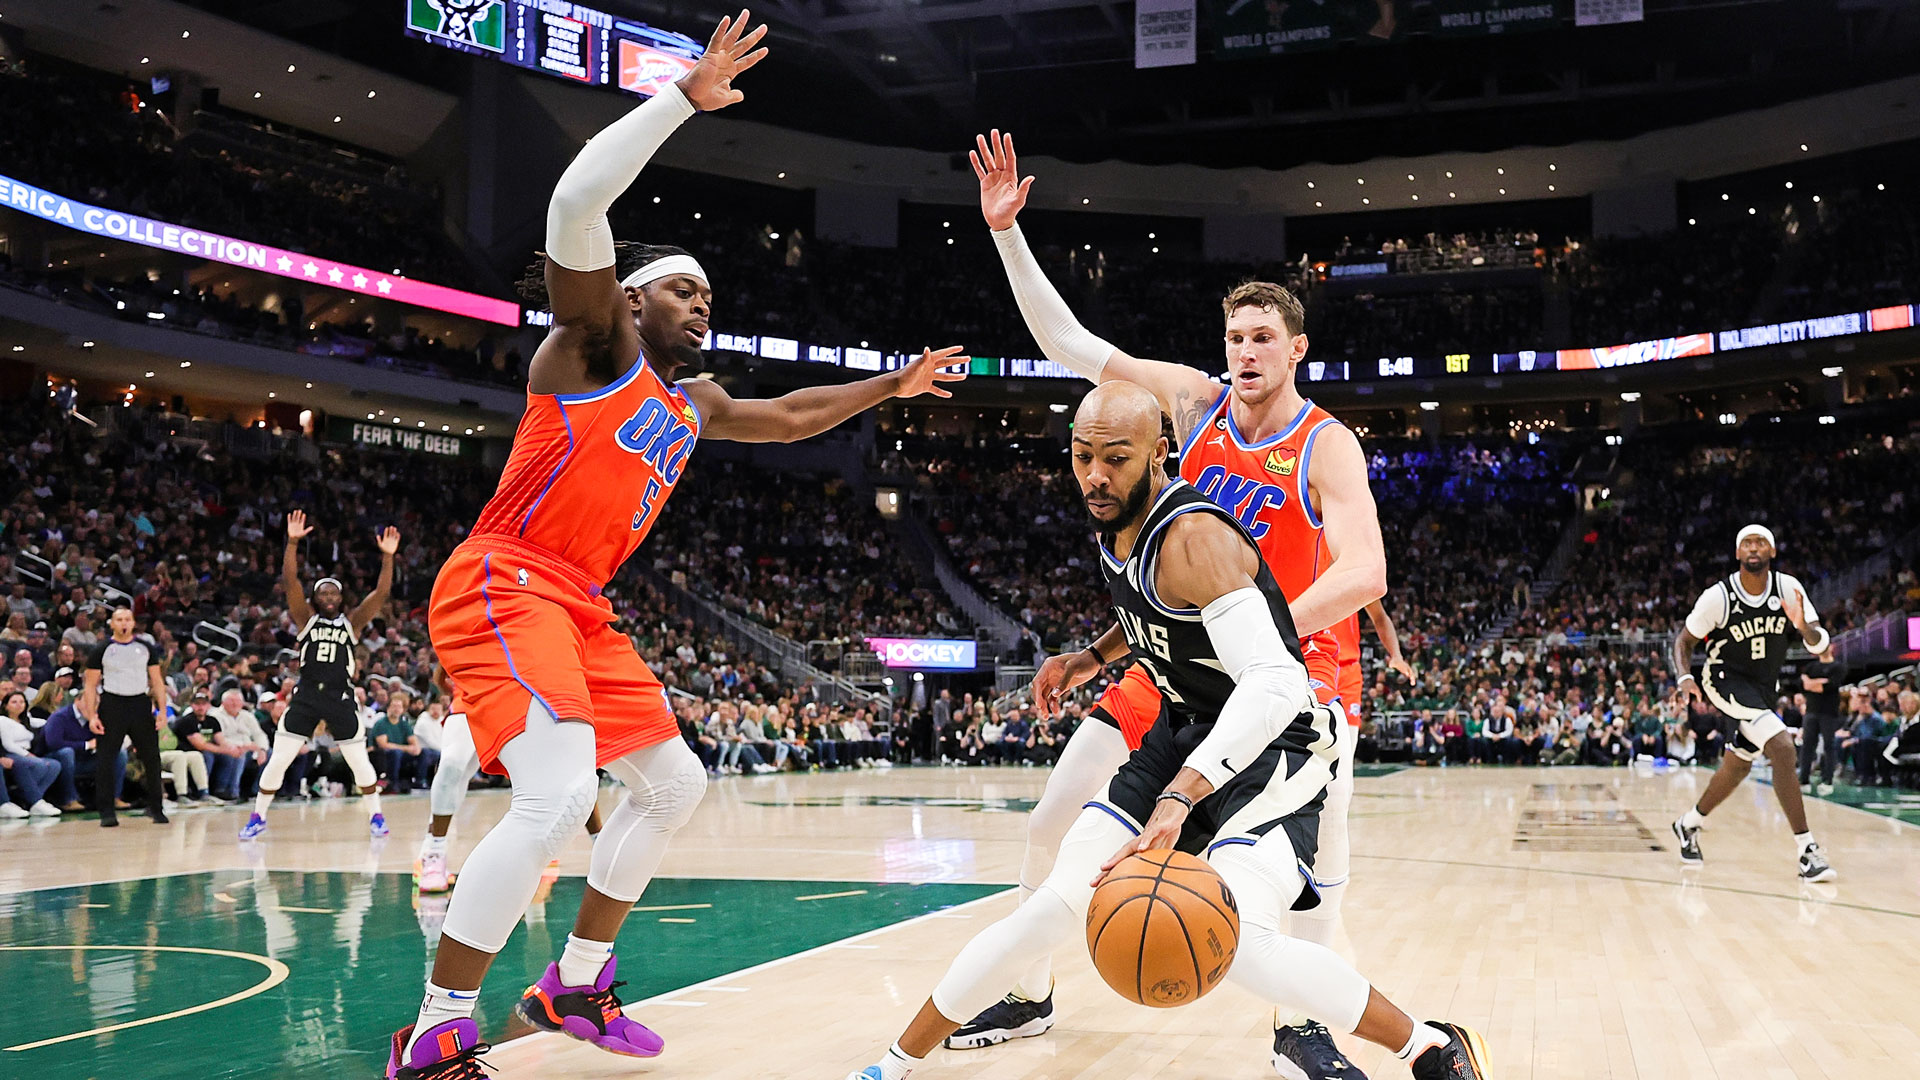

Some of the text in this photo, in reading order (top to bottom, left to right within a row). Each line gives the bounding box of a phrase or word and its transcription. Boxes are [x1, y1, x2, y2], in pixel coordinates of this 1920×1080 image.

[1224, 25, 1331, 48] WORLD CHAMPIONS
[83, 208, 267, 268] COLLECTION
[1780, 320, 1808, 343] CITY
[1807, 312, 1861, 339] THUNDER
[1378, 357, 1414, 376] 6:48
[1445, 354, 1471, 373] 1ST
[353, 423, 392, 446] FEAR
[424, 434, 460, 455] DEER
[614, 396, 697, 488] OKC
[631, 476, 662, 530] 5
[1194, 464, 1287, 540] OKC
[310, 626, 349, 645] BUCKS
[1729, 616, 1787, 643] BUCKS
[316, 642, 337, 663] 21
[1750, 636, 1766, 660] 9
